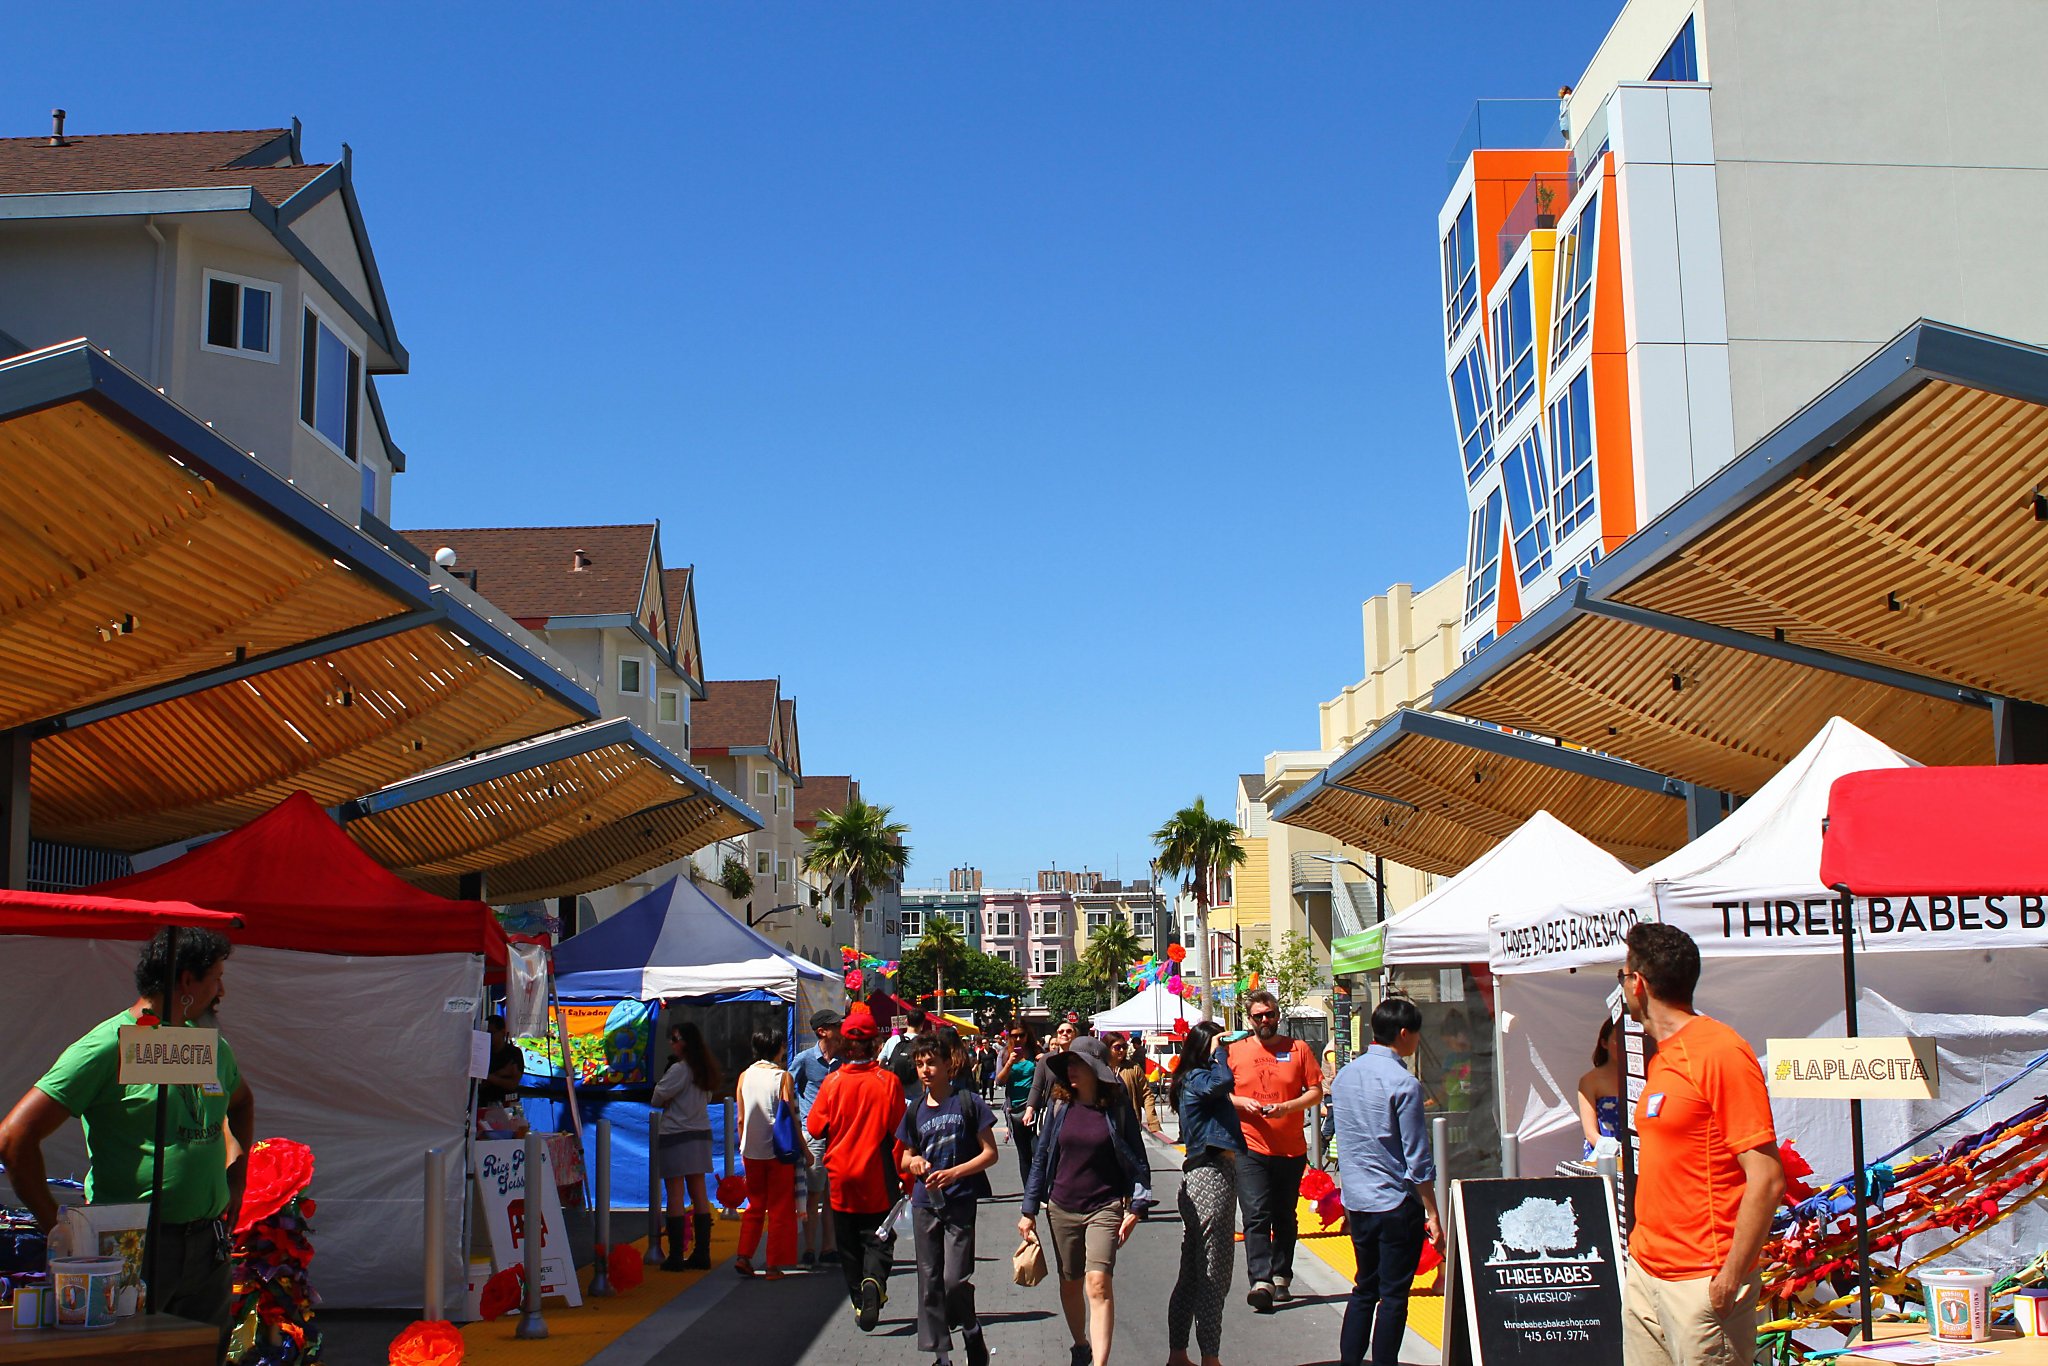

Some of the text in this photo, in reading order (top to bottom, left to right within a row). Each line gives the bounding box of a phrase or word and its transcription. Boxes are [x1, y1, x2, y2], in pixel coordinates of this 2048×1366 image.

[1713, 897, 1857, 938] THREE
[1868, 895, 2009, 934] BABES
[1500, 927, 1532, 960] THREE
[1532, 918, 1568, 956] BABES
[1774, 1058, 1930, 1082] #LAPLACITA
[483, 1154, 510, 1178] Rice
[1496, 1265, 1593, 1285] THREE BABES
[1518, 1291, 1573, 1304] BAKESHOP
[1973, 1292, 1981, 1329] DONATIONS
[1503, 1318, 1601, 1330] threebabesbakeshop.com
[1524, 1330, 1590, 1342] 415.617.9774
